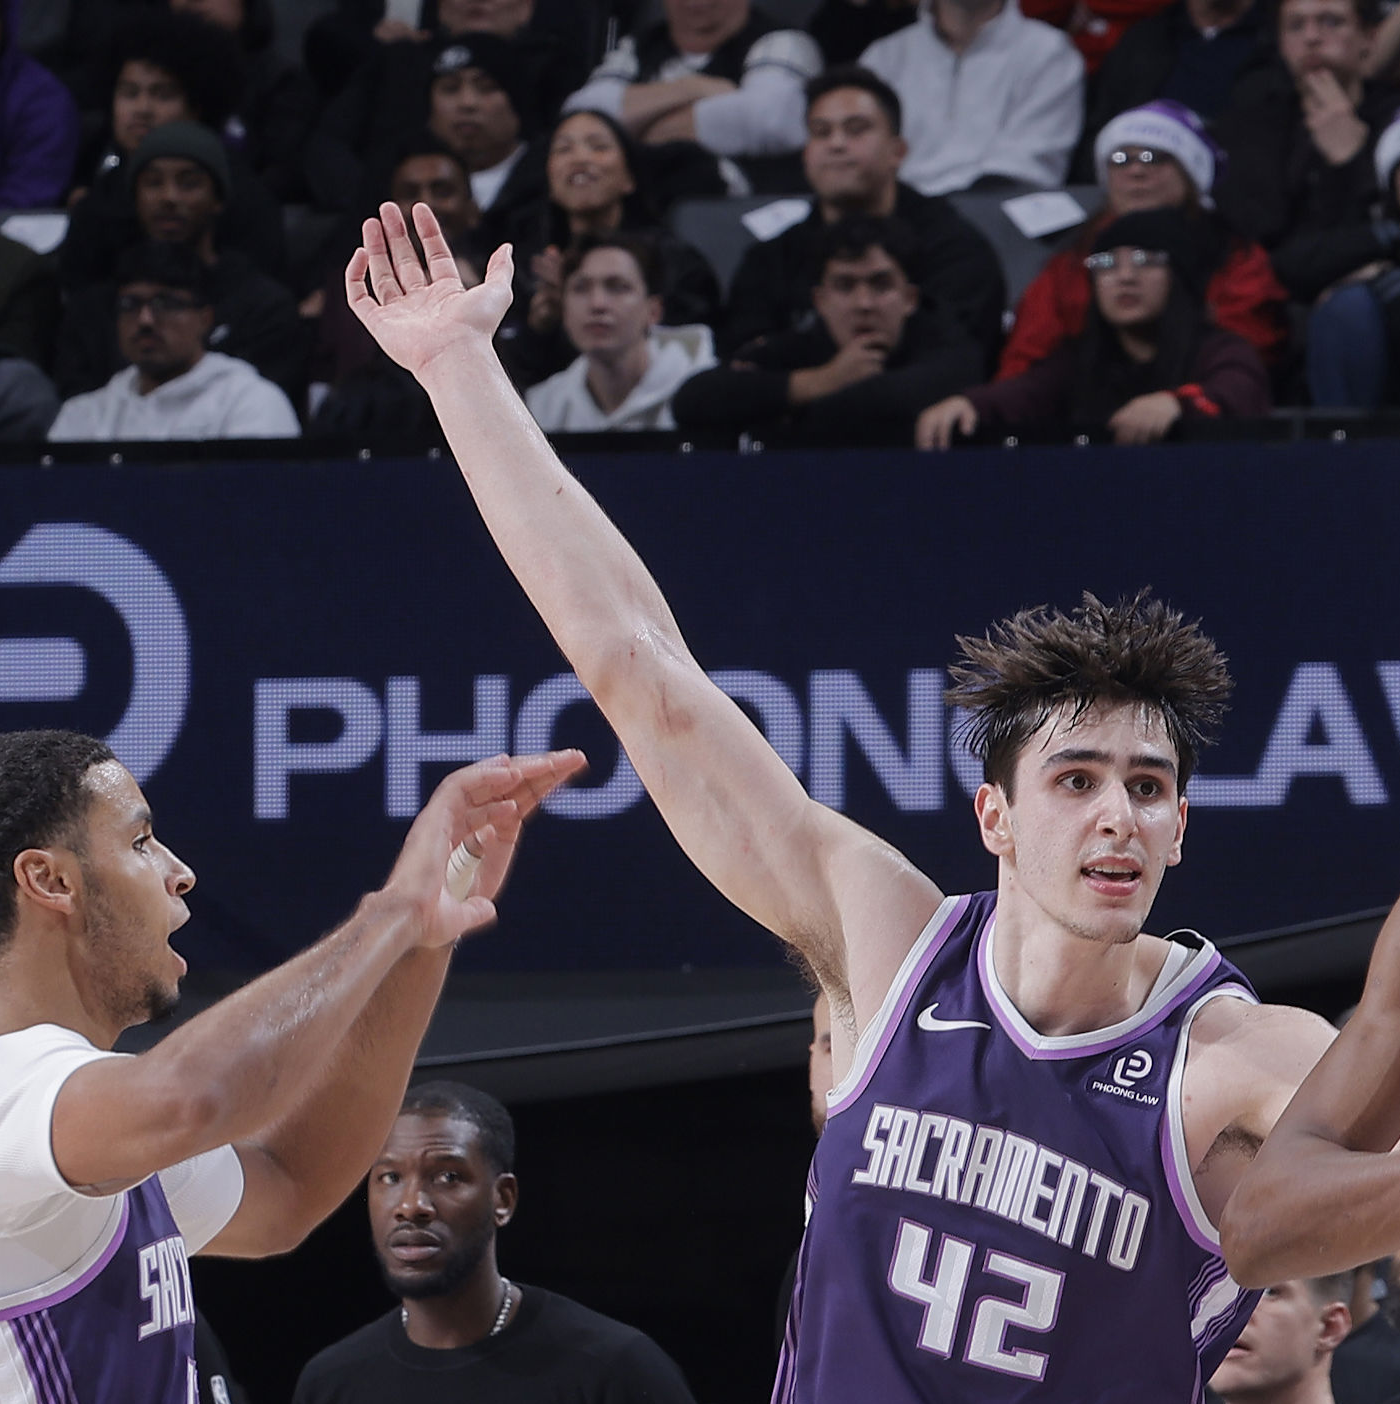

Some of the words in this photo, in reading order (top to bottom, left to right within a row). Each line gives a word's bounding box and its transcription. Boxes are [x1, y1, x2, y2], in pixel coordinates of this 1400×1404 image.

[1092, 1081, 1136, 1099] PHOONG
[1135, 1092, 1159, 1106] LAW
[851, 1103, 1150, 1272] SACRAMENTO
[887, 1217, 1066, 1382] 42
